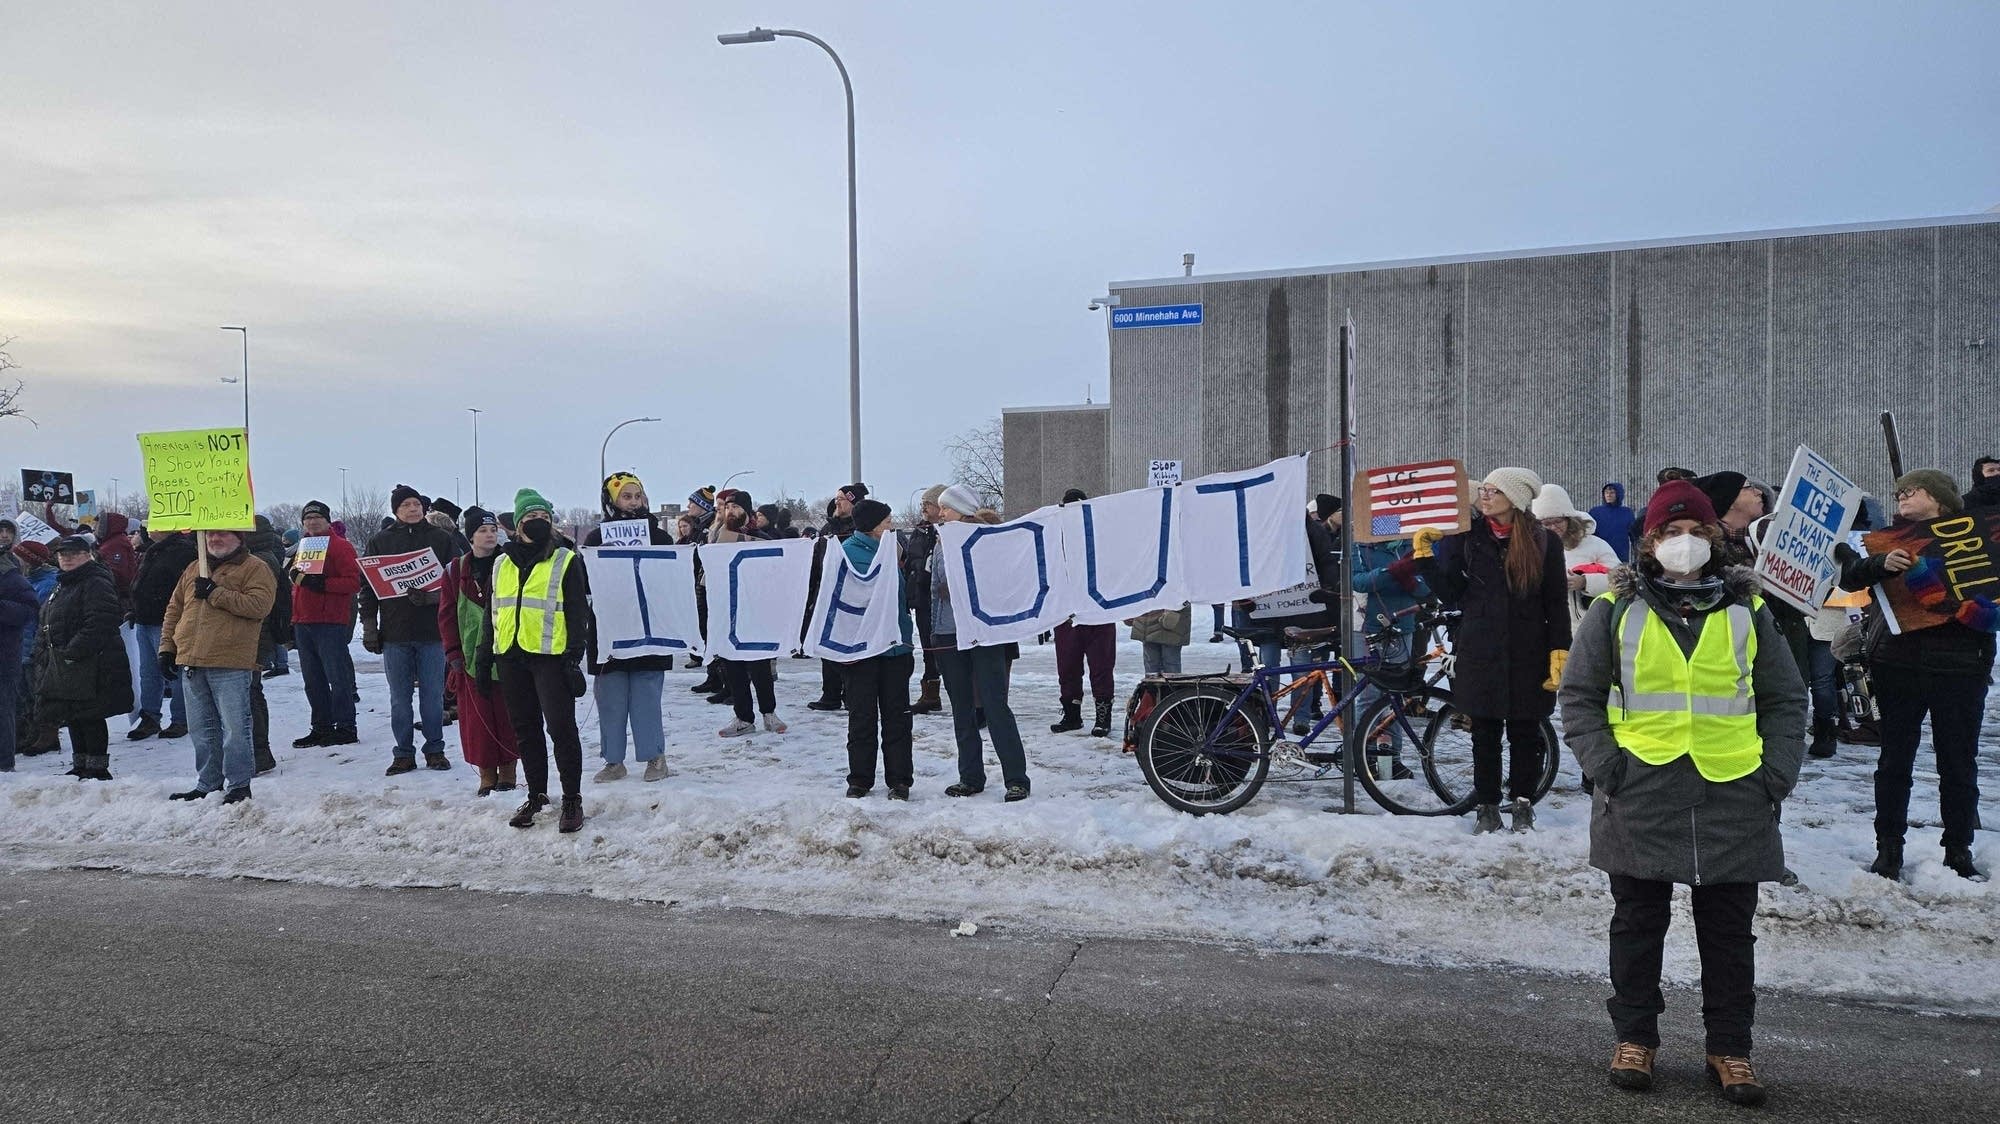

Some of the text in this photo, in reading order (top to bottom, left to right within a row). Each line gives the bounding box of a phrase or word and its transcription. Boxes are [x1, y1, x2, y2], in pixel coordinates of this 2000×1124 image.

[1114, 309, 1200, 323] 6000 Minnehaha Ave.
[144, 434, 242, 453] America is NOT
[149, 457, 157, 473] A
[167, 455, 206, 472] Show
[1386, 471, 1419, 487] ICE
[1806, 463, 1847, 500] THE ONLY
[153, 486, 239, 515] STOP This
[1387, 490, 1425, 506] OUT
[1803, 488, 1832, 522] ICE
[21, 515, 51, 537] LOVE
[605, 524, 647, 539] FAMILY
[1788, 512, 1834, 553] I WANT
[301, 550, 322, 560] OUT
[1775, 528, 1825, 574] IS FOR MY
[1931, 516, 2000, 601] DRILL
[384, 555, 430, 577] DISSENT IS
[598, 472, 1274, 654] ICE OUT
[397, 569, 438, 590] PATRIOTIC
[1762, 552, 1816, 601] MARGARITA
[1277, 597, 1309, 609] POWER
